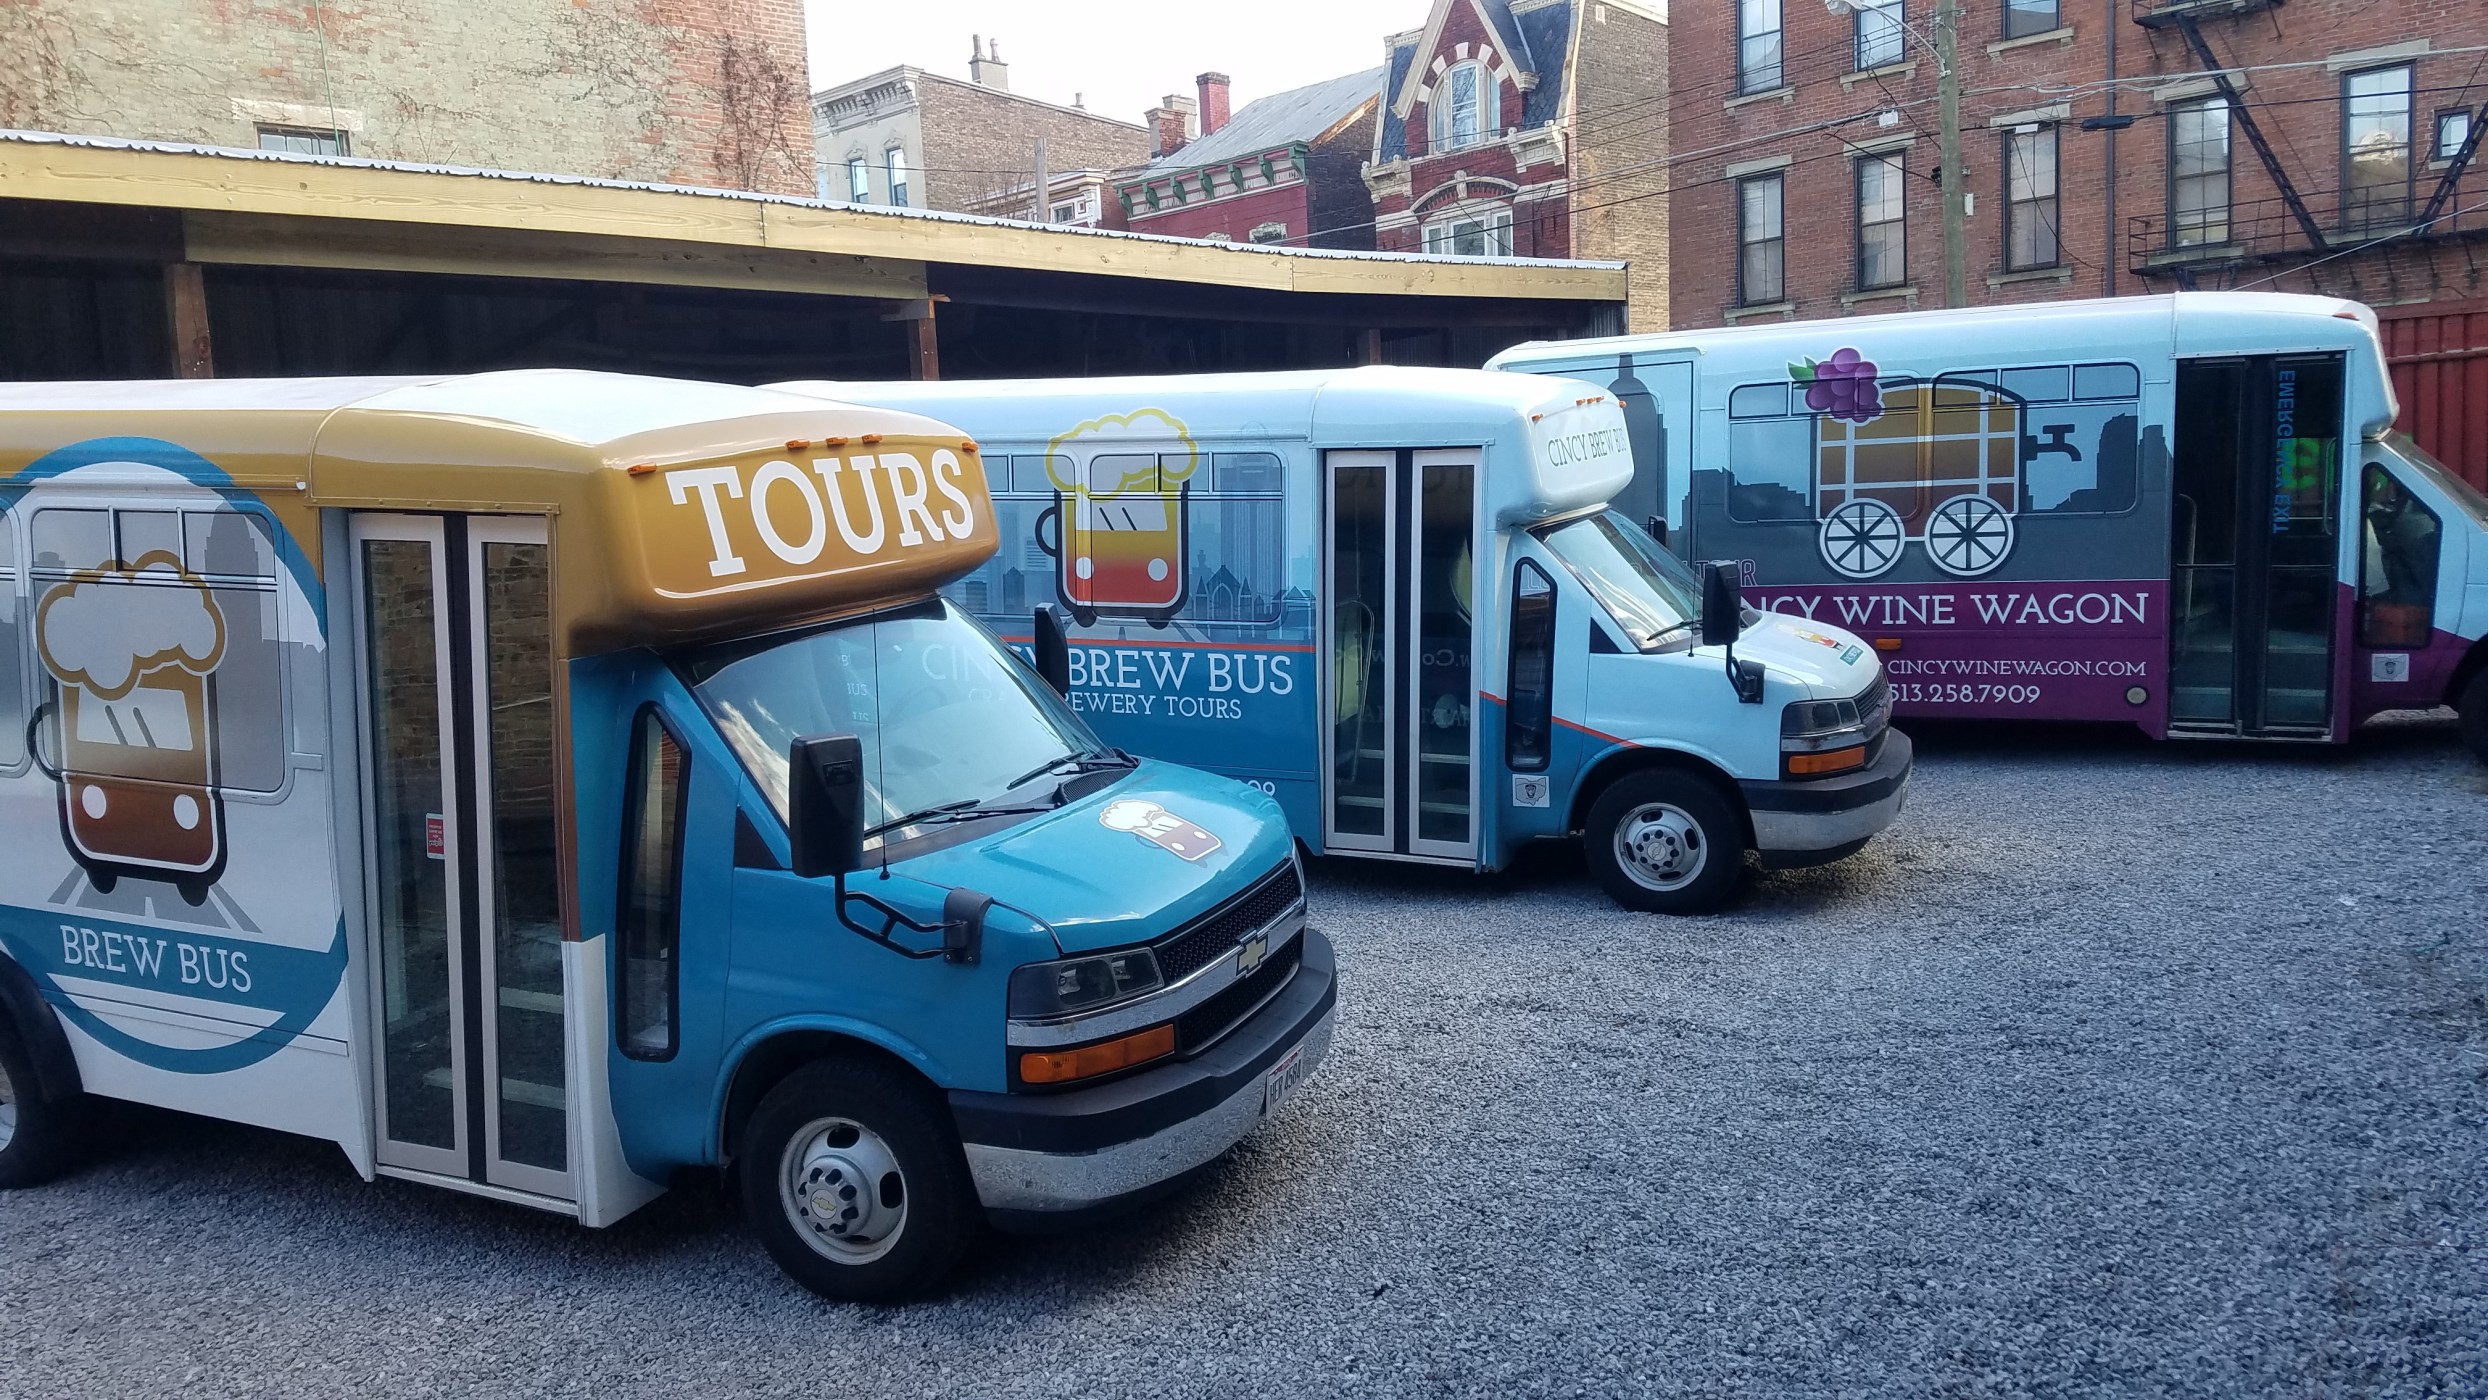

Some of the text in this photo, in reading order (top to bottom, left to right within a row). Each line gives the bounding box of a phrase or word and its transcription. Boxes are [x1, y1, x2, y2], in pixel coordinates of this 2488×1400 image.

[1547, 434, 1588, 467] CINCY
[1588, 429, 1614, 459] BREW
[665, 448, 974, 577] TOURS
[1833, 594, 1956, 626] WINE
[1969, 593, 2149, 625] WAGON
[1068, 647, 1195, 691] BREW
[1208, 653, 1293, 695] BUS
[1887, 659, 2147, 676] CINCYWINEWAGON.COM
[1065, 691, 1242, 719] EWERY TOURS
[1888, 683, 2041, 704] 513.258.7909
[60, 925, 251, 993] BREW BUS
